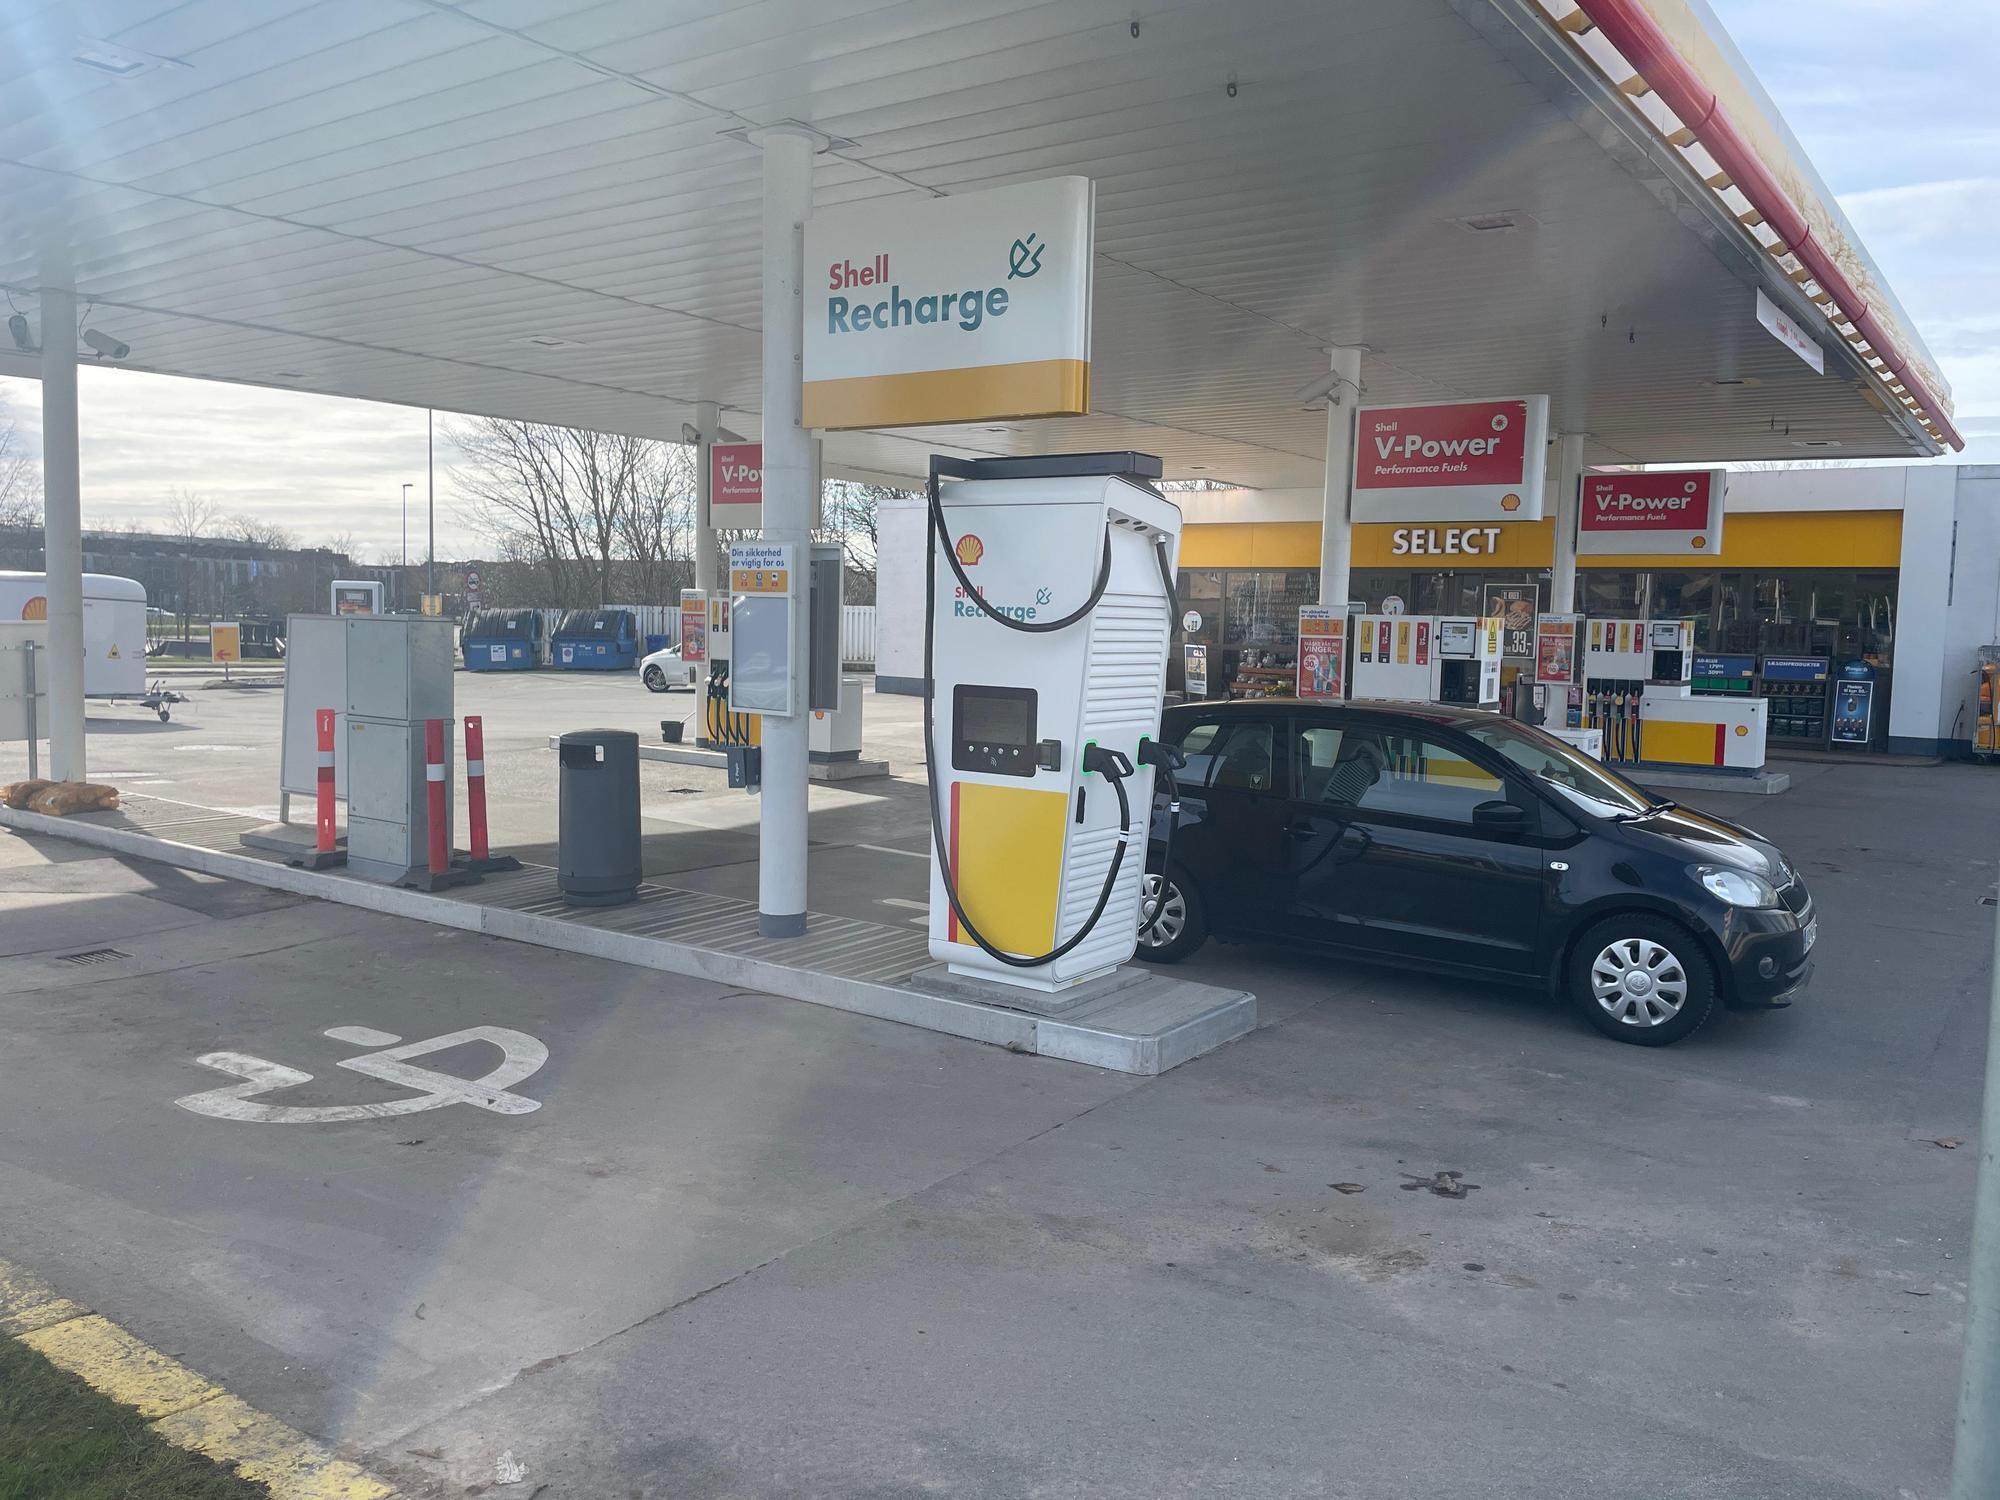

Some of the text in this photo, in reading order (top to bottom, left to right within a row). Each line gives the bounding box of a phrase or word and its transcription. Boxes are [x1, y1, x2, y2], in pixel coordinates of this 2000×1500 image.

[829, 253, 889, 290] Shell
[828, 285, 1009, 335] Recharge
[1375, 422, 1398, 432] Shell
[1374, 434, 1500, 460] V-Power
[721, 464, 763, 483] V-Po
[1375, 462, 1468, 475] Performance Fuels
[1595, 493, 1692, 511] V-Power
[1595, 513, 1667, 522] Performance Fuels
[1391, 527, 1502, 555] SELECT
[731, 547, 782, 557] Din sikkerhed
[742, 558, 762, 569] vigtig
[763, 558, 774, 567] for
[955, 585, 984, 598] Shll
[954, 600, 1037, 624] Recarge
